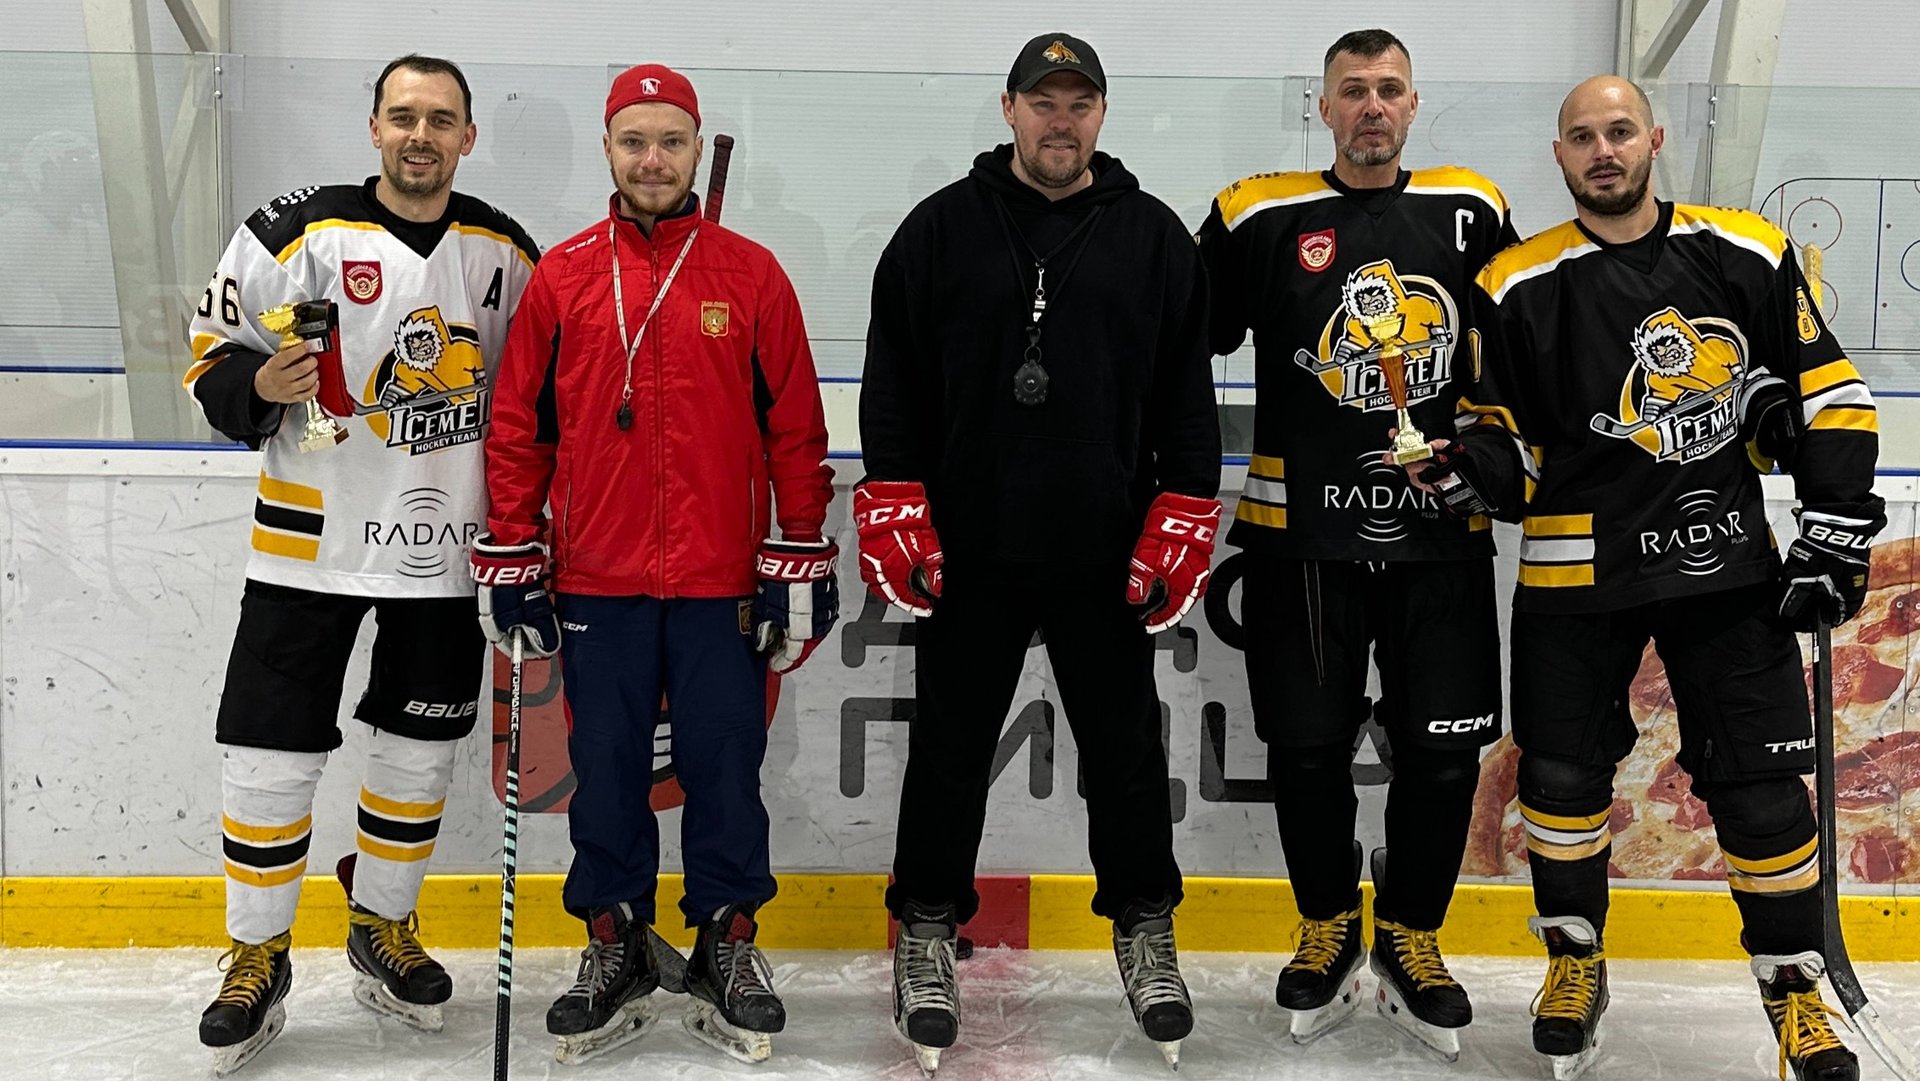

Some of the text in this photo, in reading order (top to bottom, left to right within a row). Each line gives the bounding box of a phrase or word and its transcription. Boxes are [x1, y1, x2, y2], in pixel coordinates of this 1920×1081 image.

[1455, 208, 1475, 252] C
[481, 266, 503, 311] A
[1658, 385, 1740, 458] ICEME
[415, 430, 479, 454] HOCKEY TEAM
[365, 521, 479, 546] RADAR
[1161, 516, 1214, 543] CC
[1640, 511, 1744, 554] RADAR
[403, 700, 478, 718] BAUE
[510, 662, 521, 732] RFORMANCE
[1427, 713, 1494, 733] CCM
